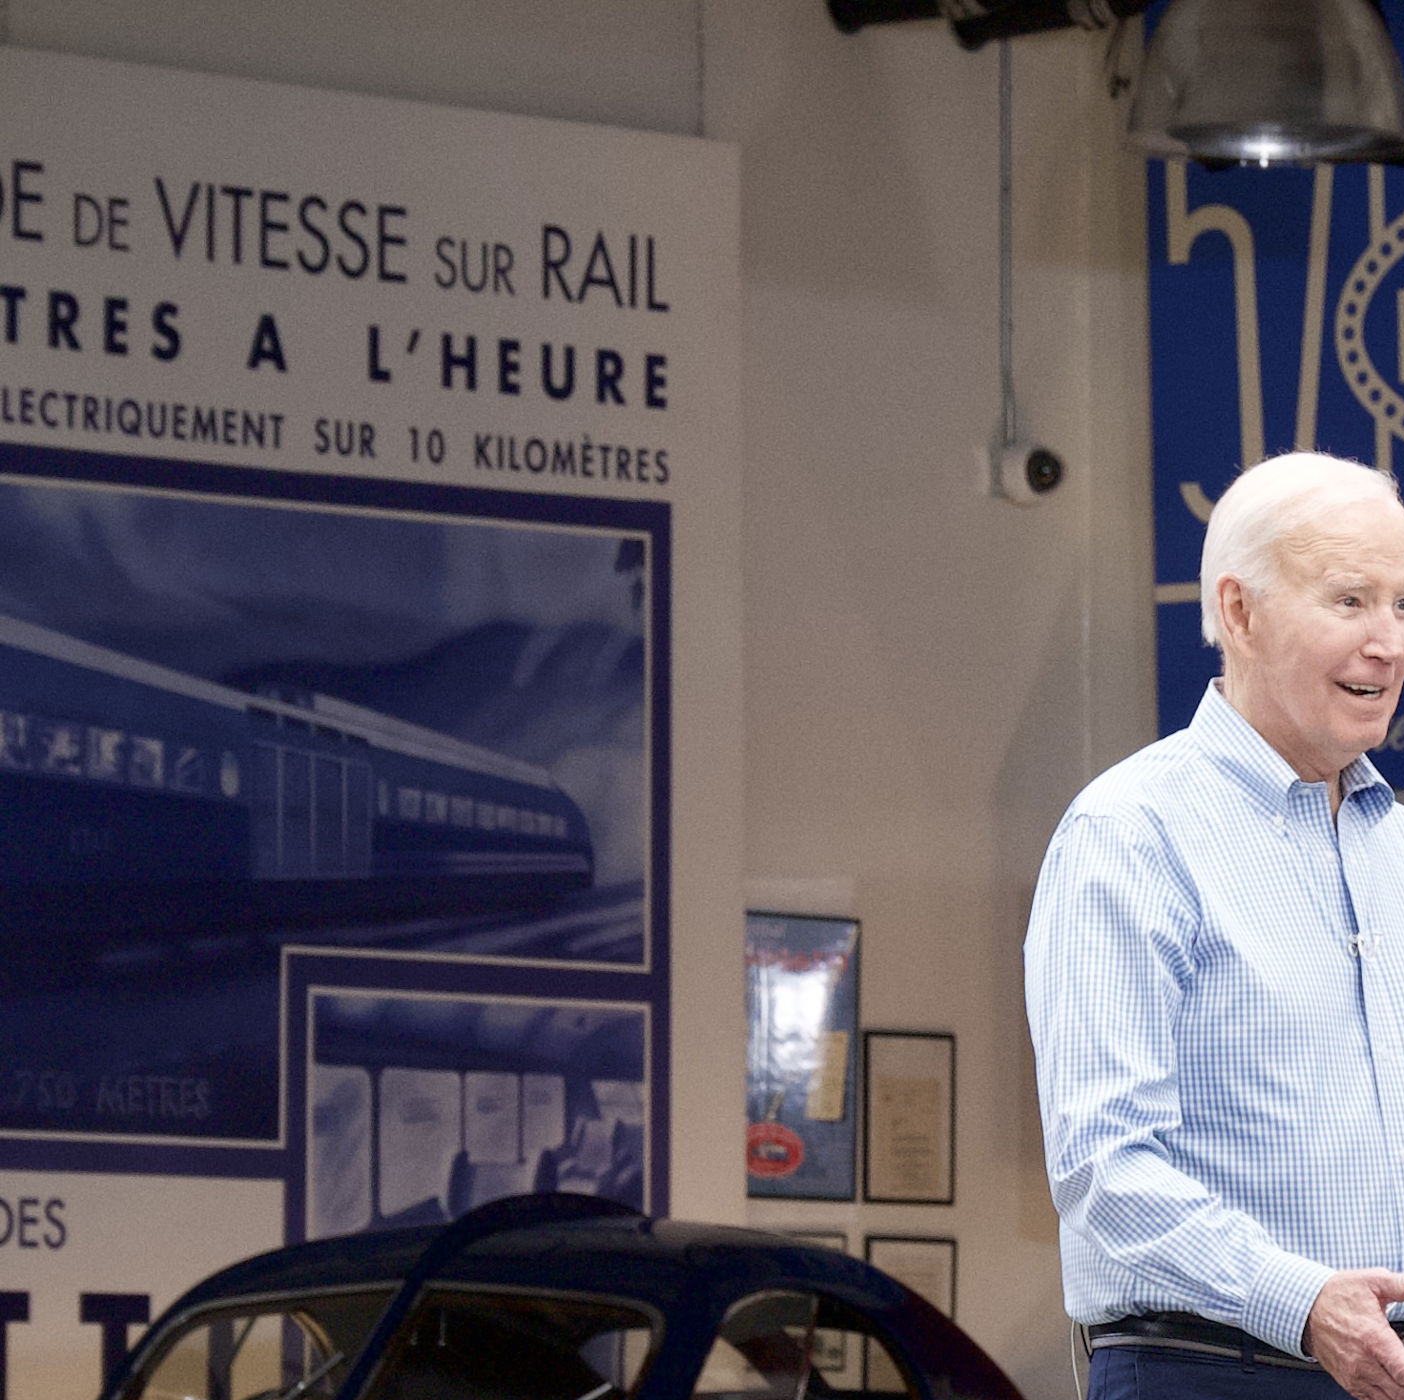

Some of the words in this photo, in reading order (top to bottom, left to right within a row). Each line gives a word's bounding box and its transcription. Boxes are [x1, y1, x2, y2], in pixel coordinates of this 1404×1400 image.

[0, 160, 44, 241] E
[73, 192, 130, 252] DE
[154, 176, 408, 284] VITESSE
[434, 235, 516, 296] SUR
[542, 223, 670, 312] RAIL
[247, 313, 288, 373] A
[368, 323, 669, 410] L'HEURE
[314, 415, 376, 459] SUR
[409, 425, 447, 465] 10
[473, 432, 671, 486] KILOMÈTRES
